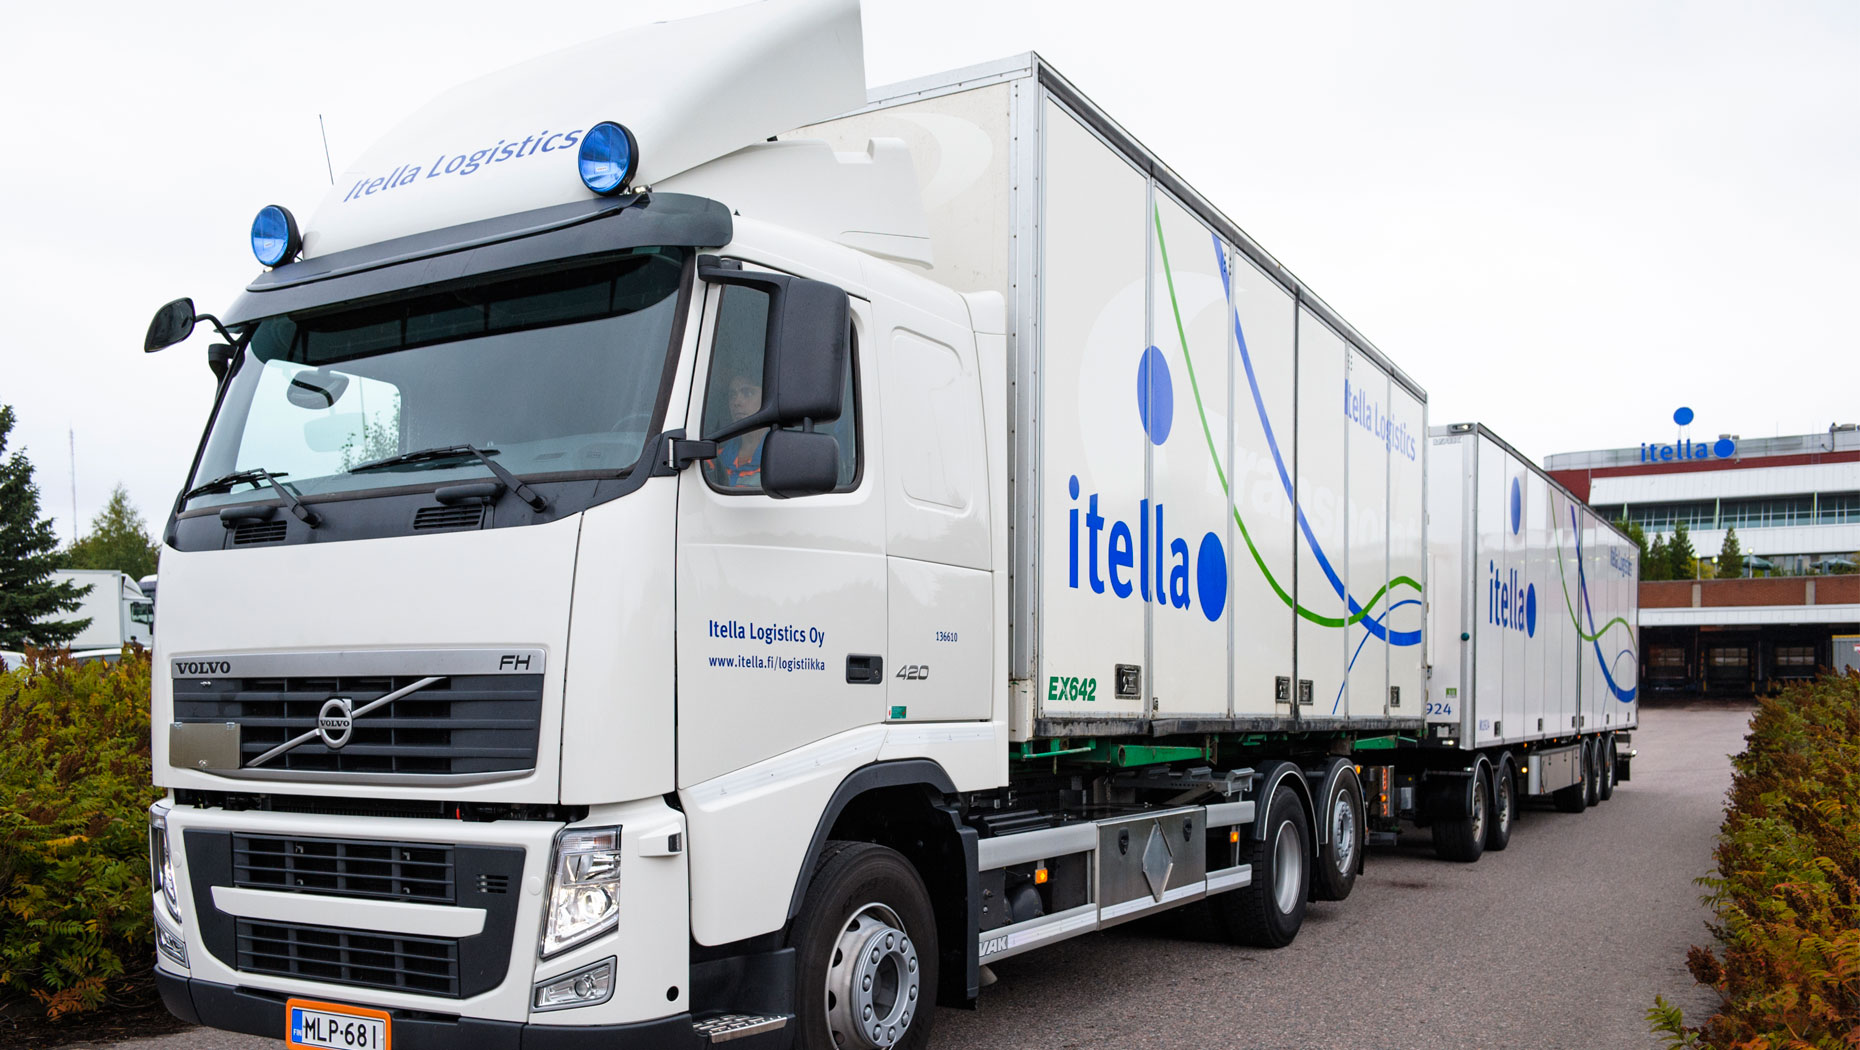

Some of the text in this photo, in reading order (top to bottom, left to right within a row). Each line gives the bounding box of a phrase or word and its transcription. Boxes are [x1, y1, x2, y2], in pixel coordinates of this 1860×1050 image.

[343, 129, 584, 202] Itella Logistics
[1345, 378, 1416, 462] Itella Logistics
[1641, 438, 1708, 462] itella
[1069, 474, 1191, 611] itella
[1489, 559, 1525, 631] itella
[709, 620, 825, 648] Itella Logistics Oy
[935, 631, 958, 642] 136610
[176, 660, 232, 675] VOLVO
[499, 654, 531, 670] FH
[708, 655, 825, 672] www.itella.fi/logistiikka
[895, 665, 929, 680] 420
[1048, 676, 1097, 702] EX642
[319, 719, 350, 728] VOLVO
[304, 1015, 376, 1049] MLP-681
